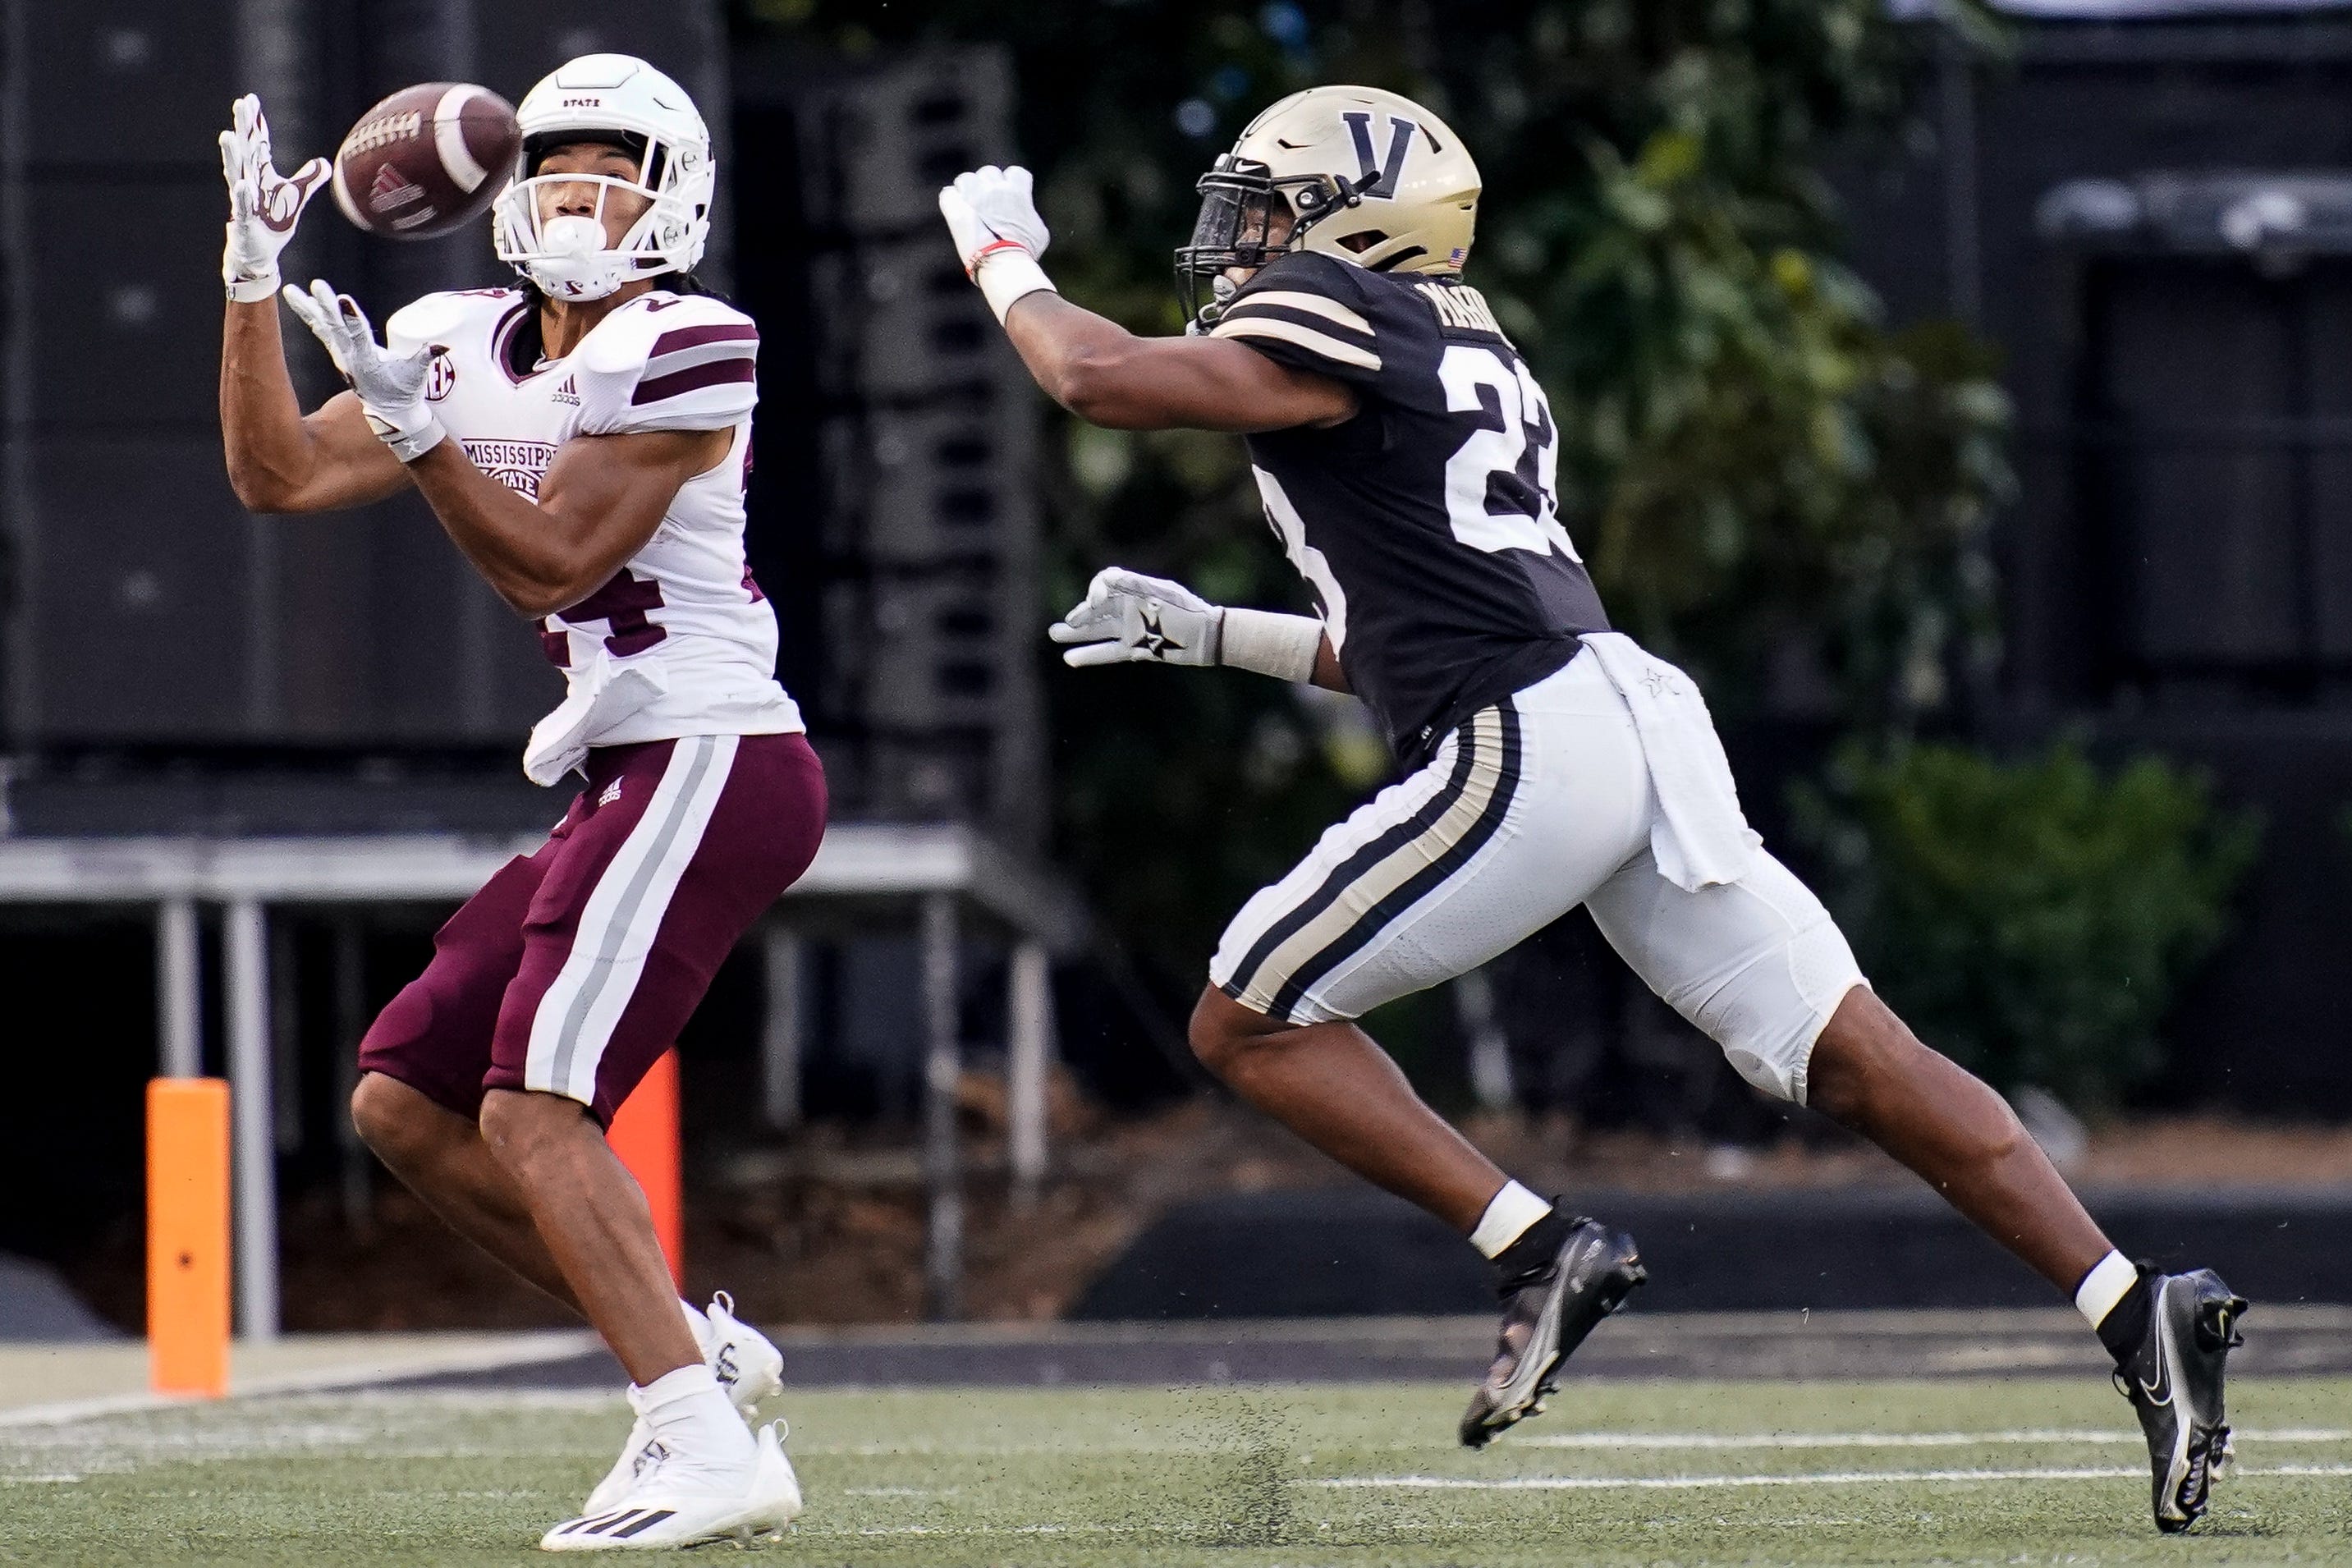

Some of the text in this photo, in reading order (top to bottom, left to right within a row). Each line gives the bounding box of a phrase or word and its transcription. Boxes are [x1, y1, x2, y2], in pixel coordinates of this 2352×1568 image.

[1340, 110, 1415, 202] V
[424, 355, 456, 401] EC
[464, 444, 558, 467] MISSISSIPP
[494, 470, 539, 496] TATE
